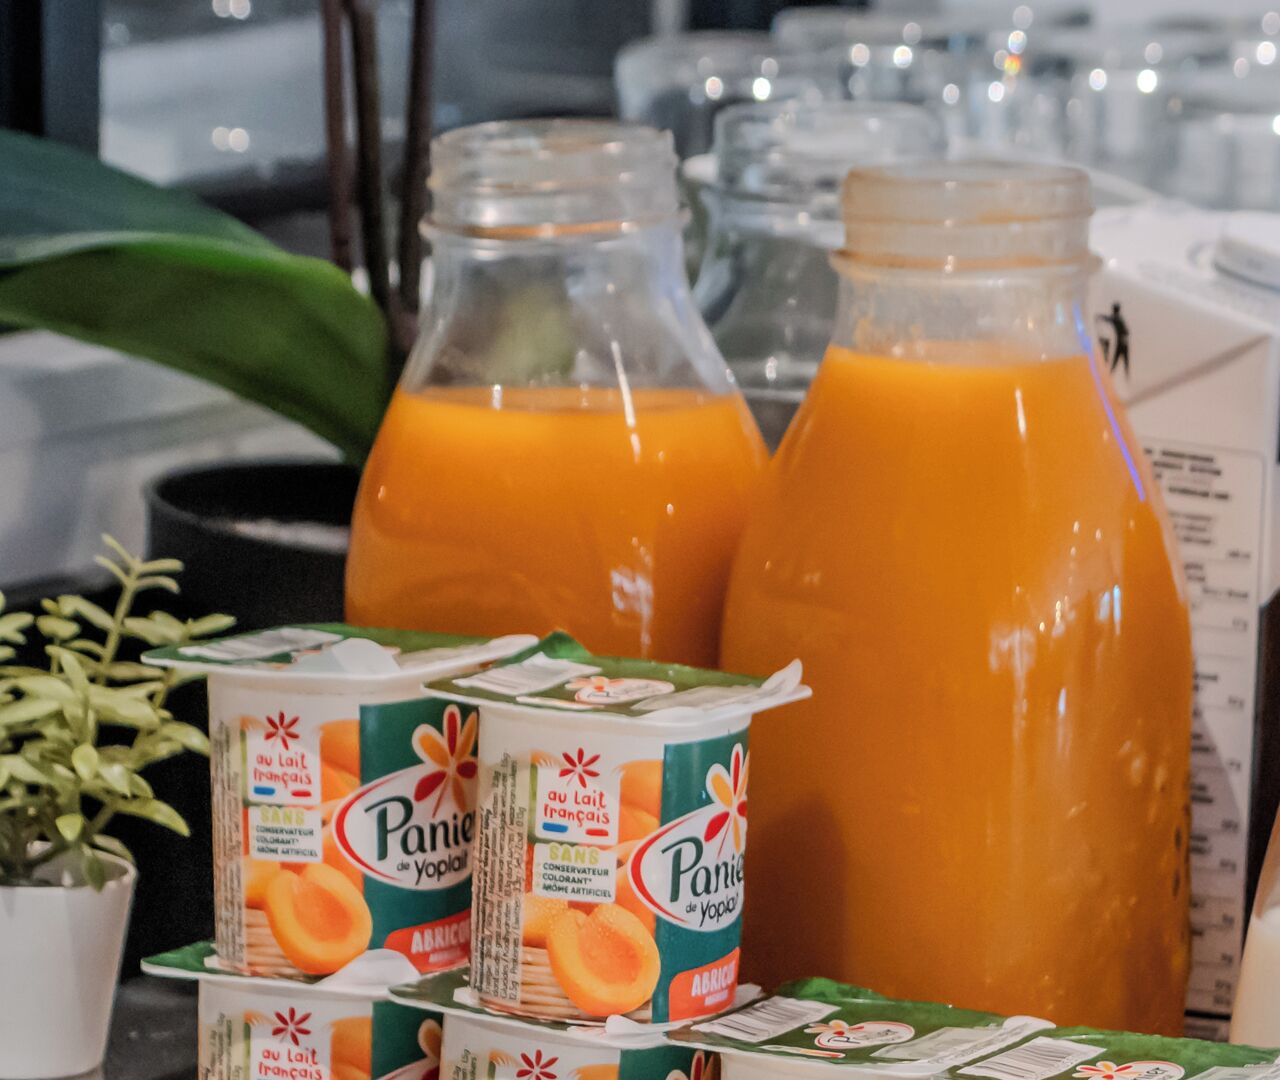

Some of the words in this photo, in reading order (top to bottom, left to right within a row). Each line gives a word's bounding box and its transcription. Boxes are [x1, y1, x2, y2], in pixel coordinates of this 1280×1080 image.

[256, 754, 273, 767] au
[253, 767, 313, 788] français
[548, 790, 567, 804] au
[543, 804, 610, 827] français
[255, 825, 314, 836] CONSERVATEUR
[364, 795, 476, 862] Panie
[549, 846, 599, 865] SANS
[397, 859, 410, 871] de
[543, 863, 609, 877] CONSERVATEUR
[661, 836, 744, 902] Panie
[570, 886, 612, 899] ARTIFICIEL
[686, 901, 697, 914] de
[411, 920, 470, 953] ABRICO
[691, 960, 736, 997] ABRICO
[263, 1048, 280, 1060] au
